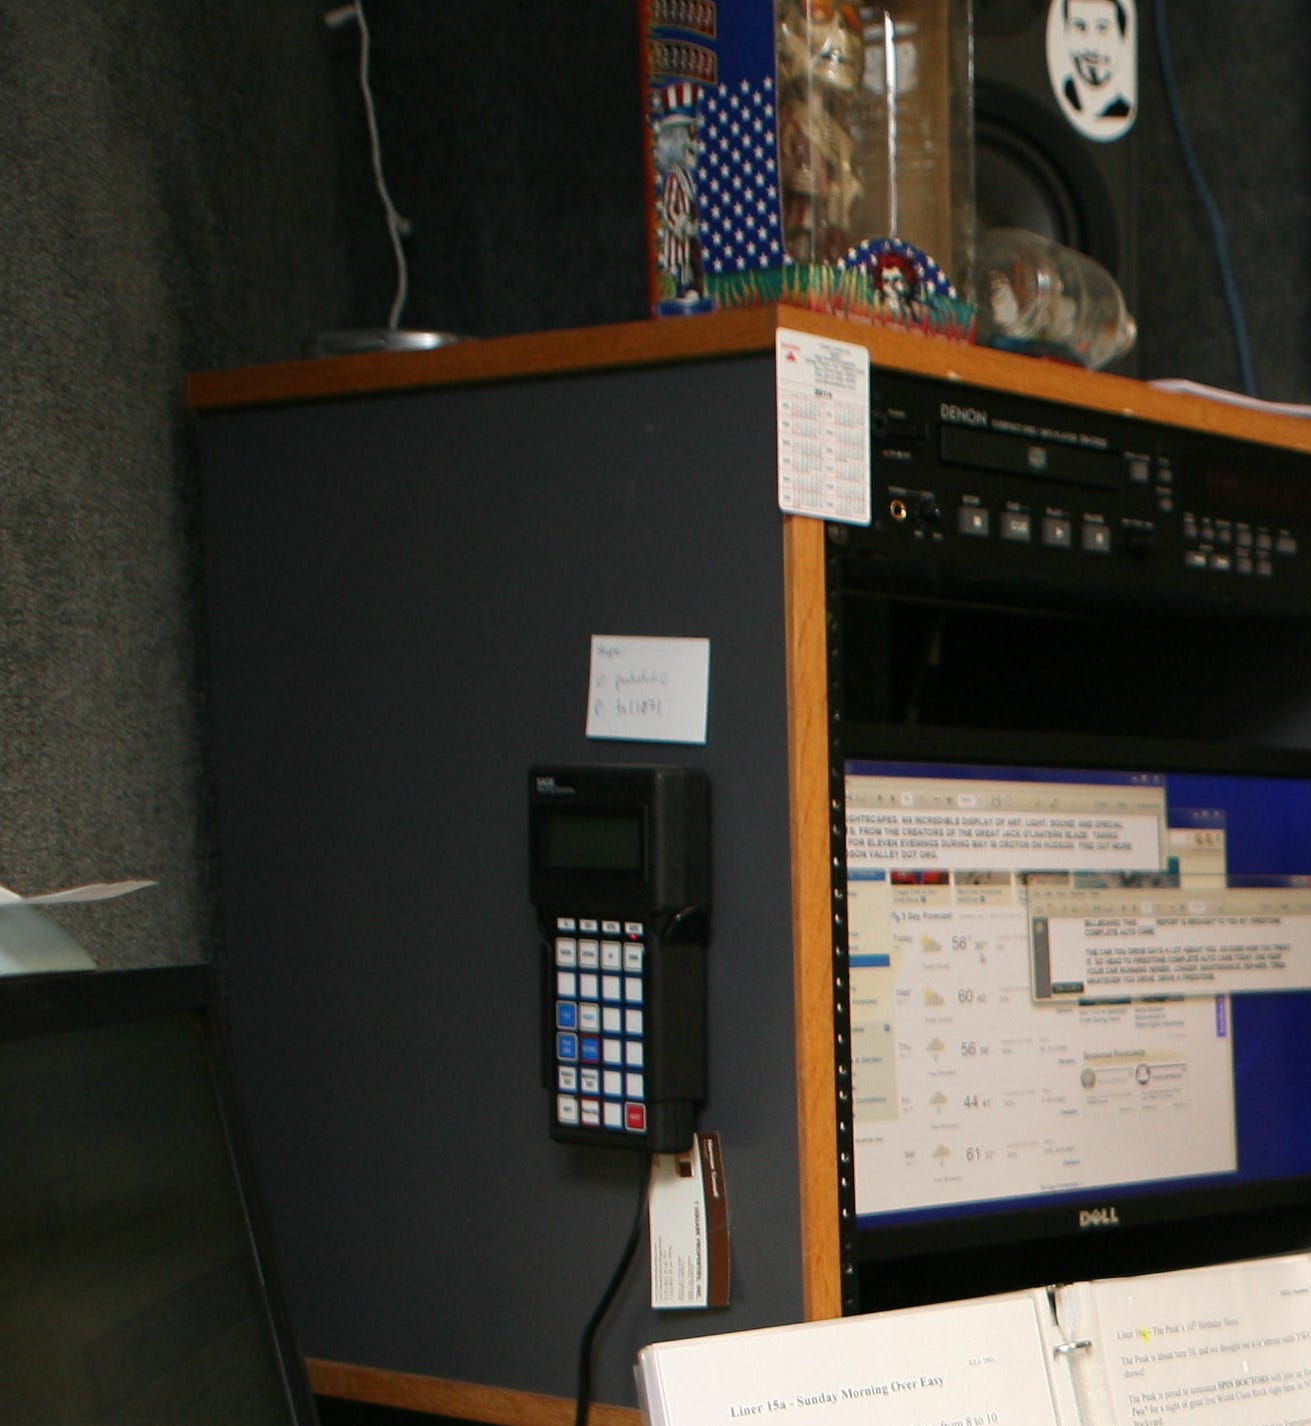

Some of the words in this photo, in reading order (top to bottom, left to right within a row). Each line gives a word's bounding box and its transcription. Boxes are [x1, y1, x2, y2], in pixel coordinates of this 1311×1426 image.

[940, 403, 988, 424] DENON
[915, 816, 960, 825] INCREDIBLE
[901, 827, 944, 836] CREATORS
[867, 837, 898, 846] ELEVEN
[901, 838, 939, 847] EVENINGS
[869, 849, 899, 858] VALLEY
[901, 850, 917, 858] DOT
[1079, 1206, 1119, 1227] DELL
[1235, 1373, 1269, 1386] DOCTORS
[730, 1406, 763, 1418] Liner
[768, 1400, 786, 1412] 15a
[796, 1393, 838, 1407] Sunday
[841, 1386, 888, 1400] Morning
[891, 1382, 917, 1392] Over
[920, 1378, 943, 1388] Easy
[966, 1417, 972, 1426] 8
[974, 1415, 983, 1426] to
[986, 1412, 998, 1424] 10
